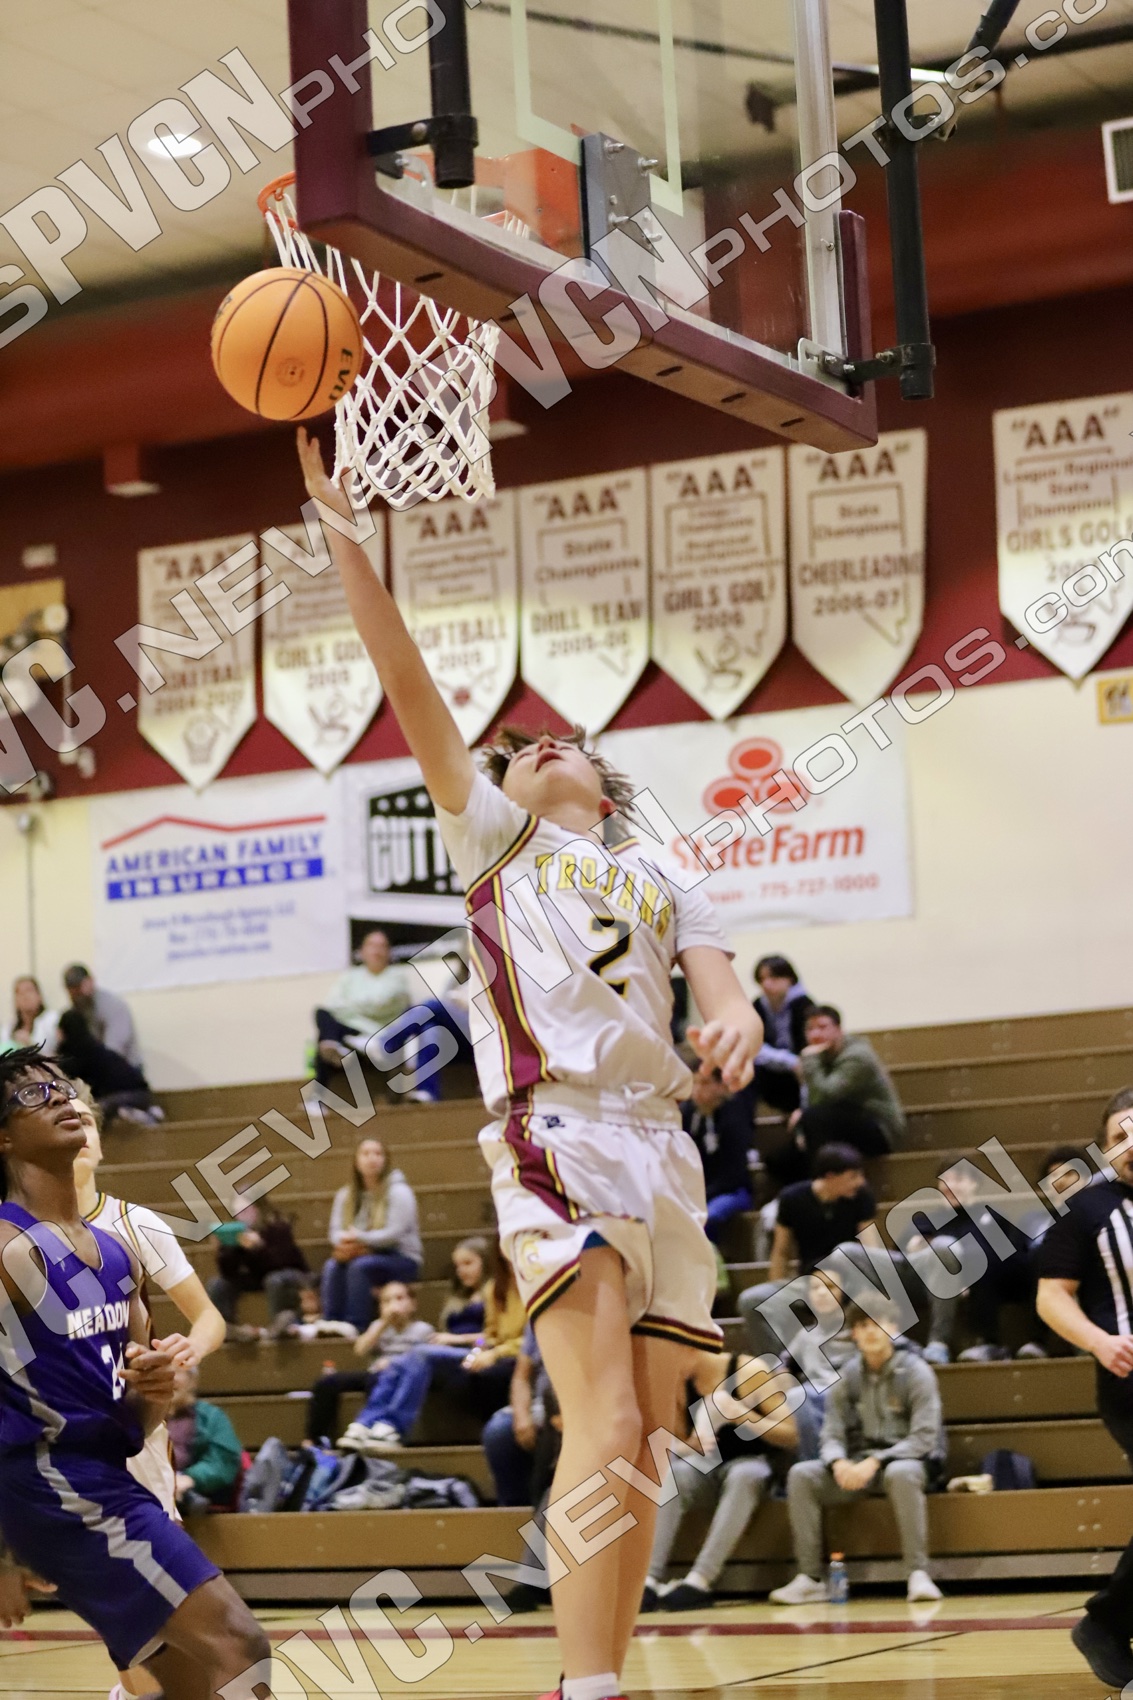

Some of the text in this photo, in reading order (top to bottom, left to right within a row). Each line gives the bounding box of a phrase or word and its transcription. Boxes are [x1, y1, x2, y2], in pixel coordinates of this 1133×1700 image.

[1006, 524, 1072, 555] GIRLS
[664, 585, 720, 613] GIRLS
[107, 831, 325, 874] AMERICAN FAMILY
[534, 852, 671, 942] TROJANS
[588, 913, 632, 999] 2
